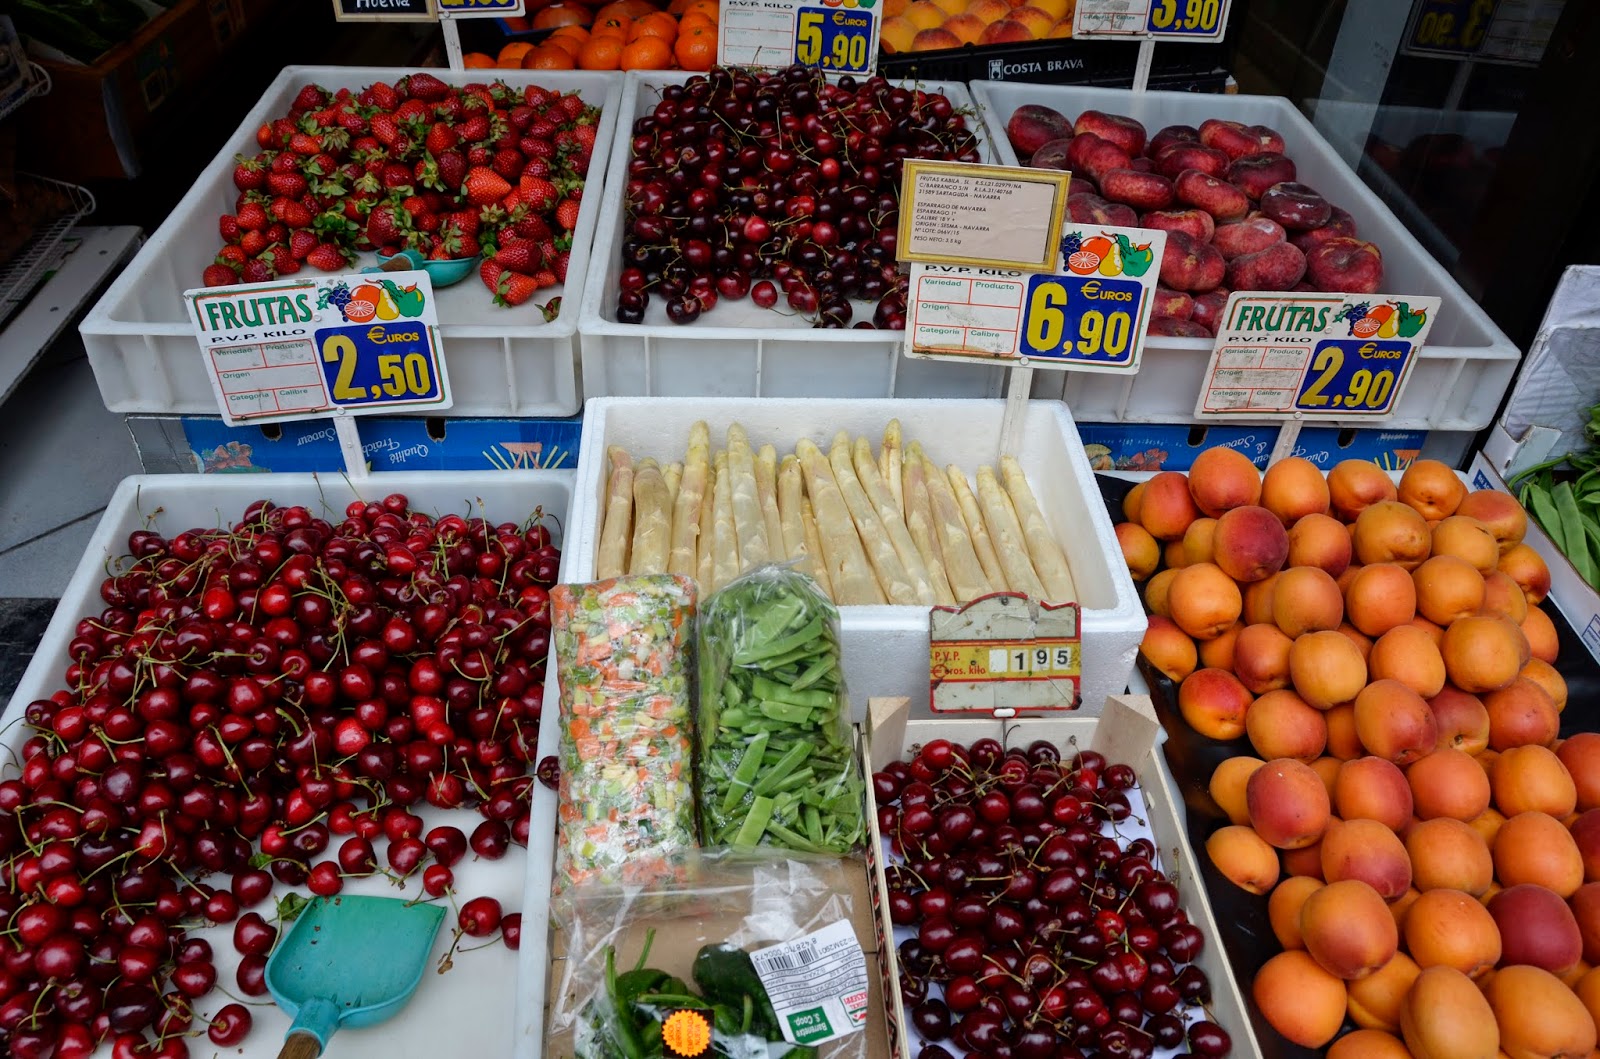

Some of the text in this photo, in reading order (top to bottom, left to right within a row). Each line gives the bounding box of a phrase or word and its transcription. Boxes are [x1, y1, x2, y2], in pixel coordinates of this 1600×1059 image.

[797, 12, 866, 68] 5,90
[1004, 59, 1084, 75] COSTA BRAVA
[925, 265, 1022, 277] P.V.P. KILO
[924, 278, 962, 286] Variedad
[976, 282, 1014, 290] Producto
[204, 294, 313, 331] FRUTAS
[1026, 282, 1131, 356] 6,90
[1235, 306, 1331, 332] FRUTAS
[212, 329, 306, 343] P.V.P. KILO
[322, 335, 430, 400] 2,50
[1298, 346, 1394, 408] 2,90
[297, 428, 336, 446] Saveur
[390, 444, 428, 464] Qualité
[1256, 442, 1266, 454] &
[968, 665, 986, 675] kilo
[794, 1015, 812, 1026] Coop.
[796, 1022, 827, 1037] Barrenetxe
